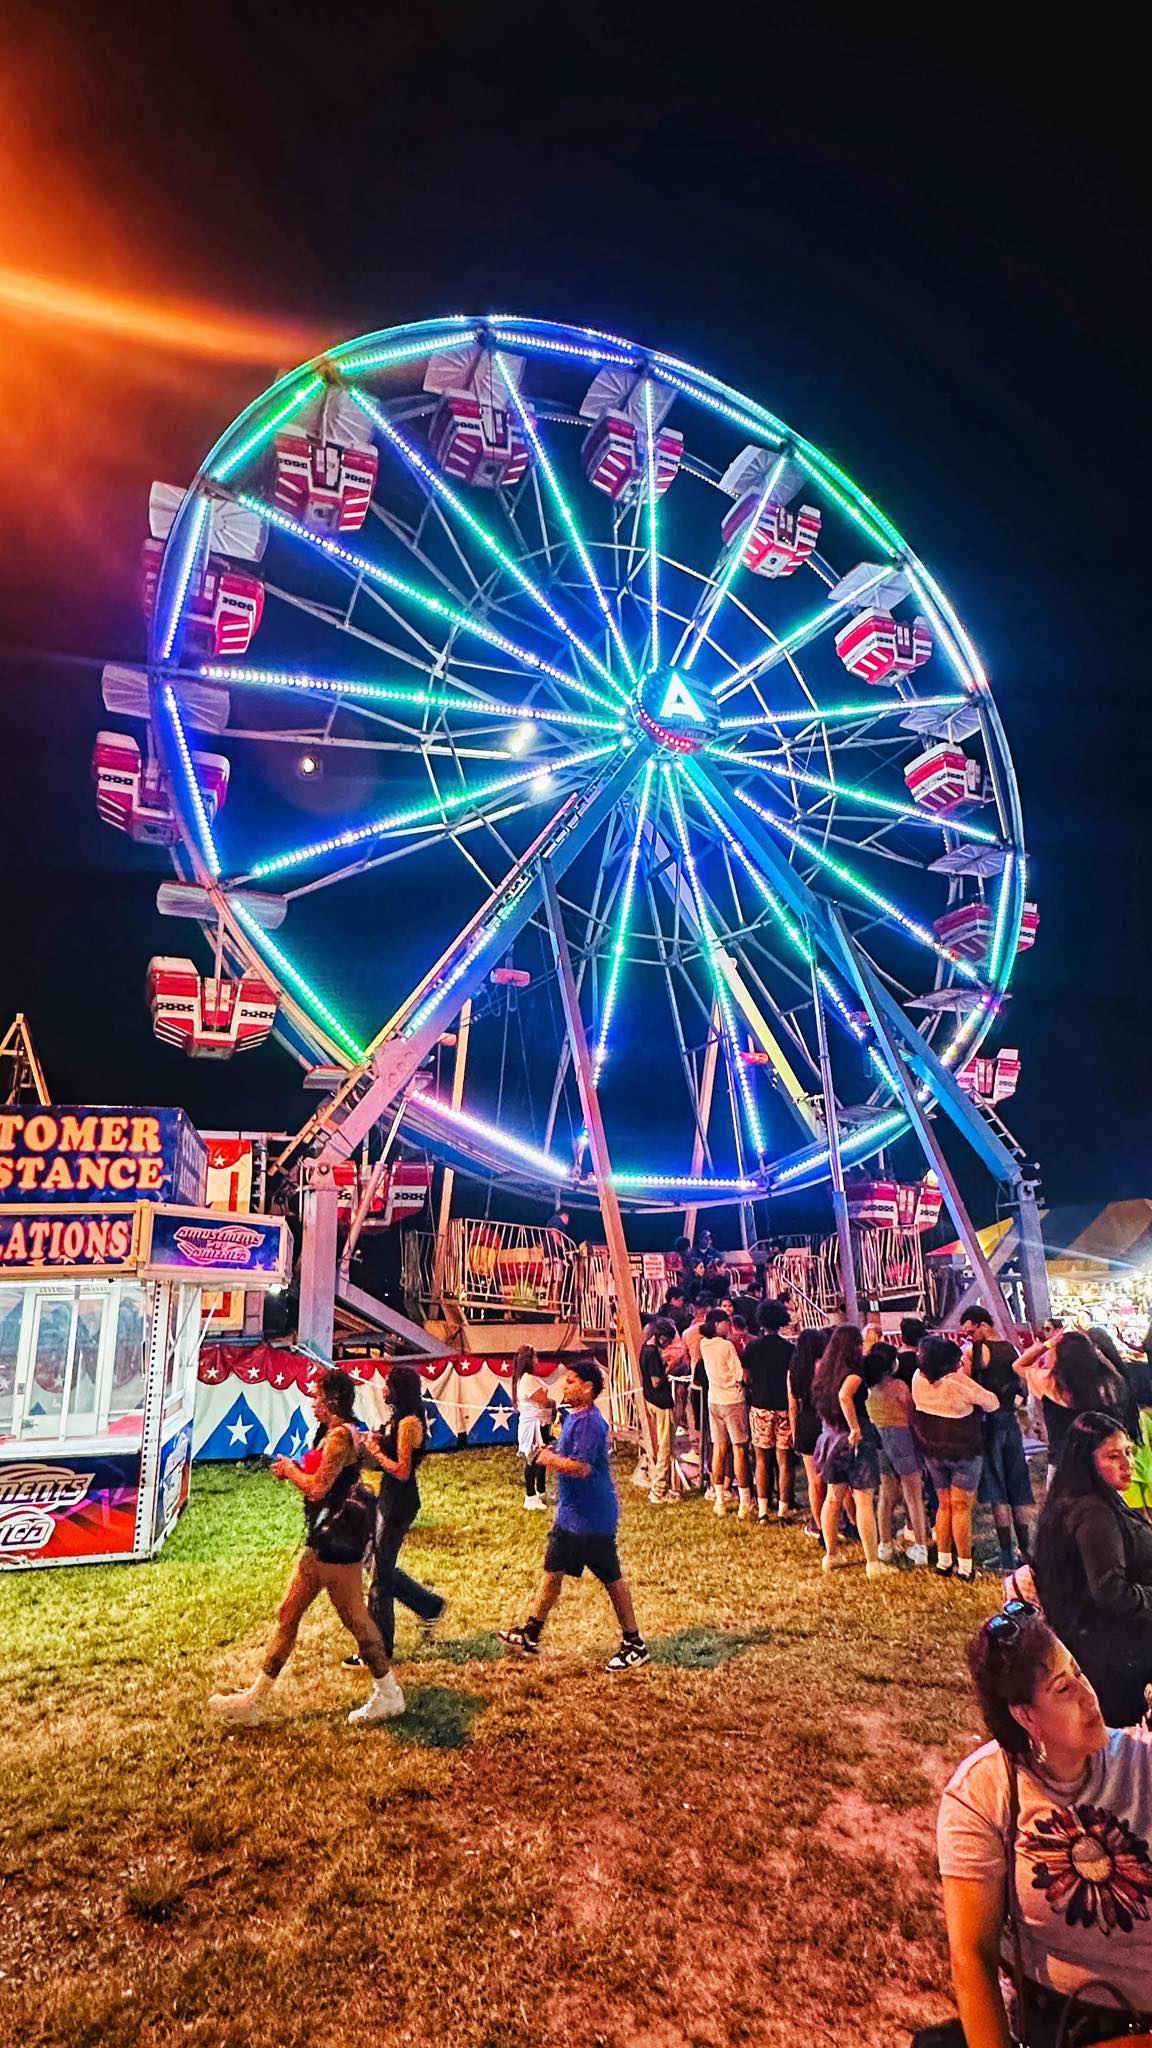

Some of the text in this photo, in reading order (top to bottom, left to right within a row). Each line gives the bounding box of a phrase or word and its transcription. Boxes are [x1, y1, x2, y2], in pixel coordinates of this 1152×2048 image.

[659, 671, 707, 722] A
[0, 1114, 162, 1153] TOMER
[0, 1221, 129, 1259] ATIONS
